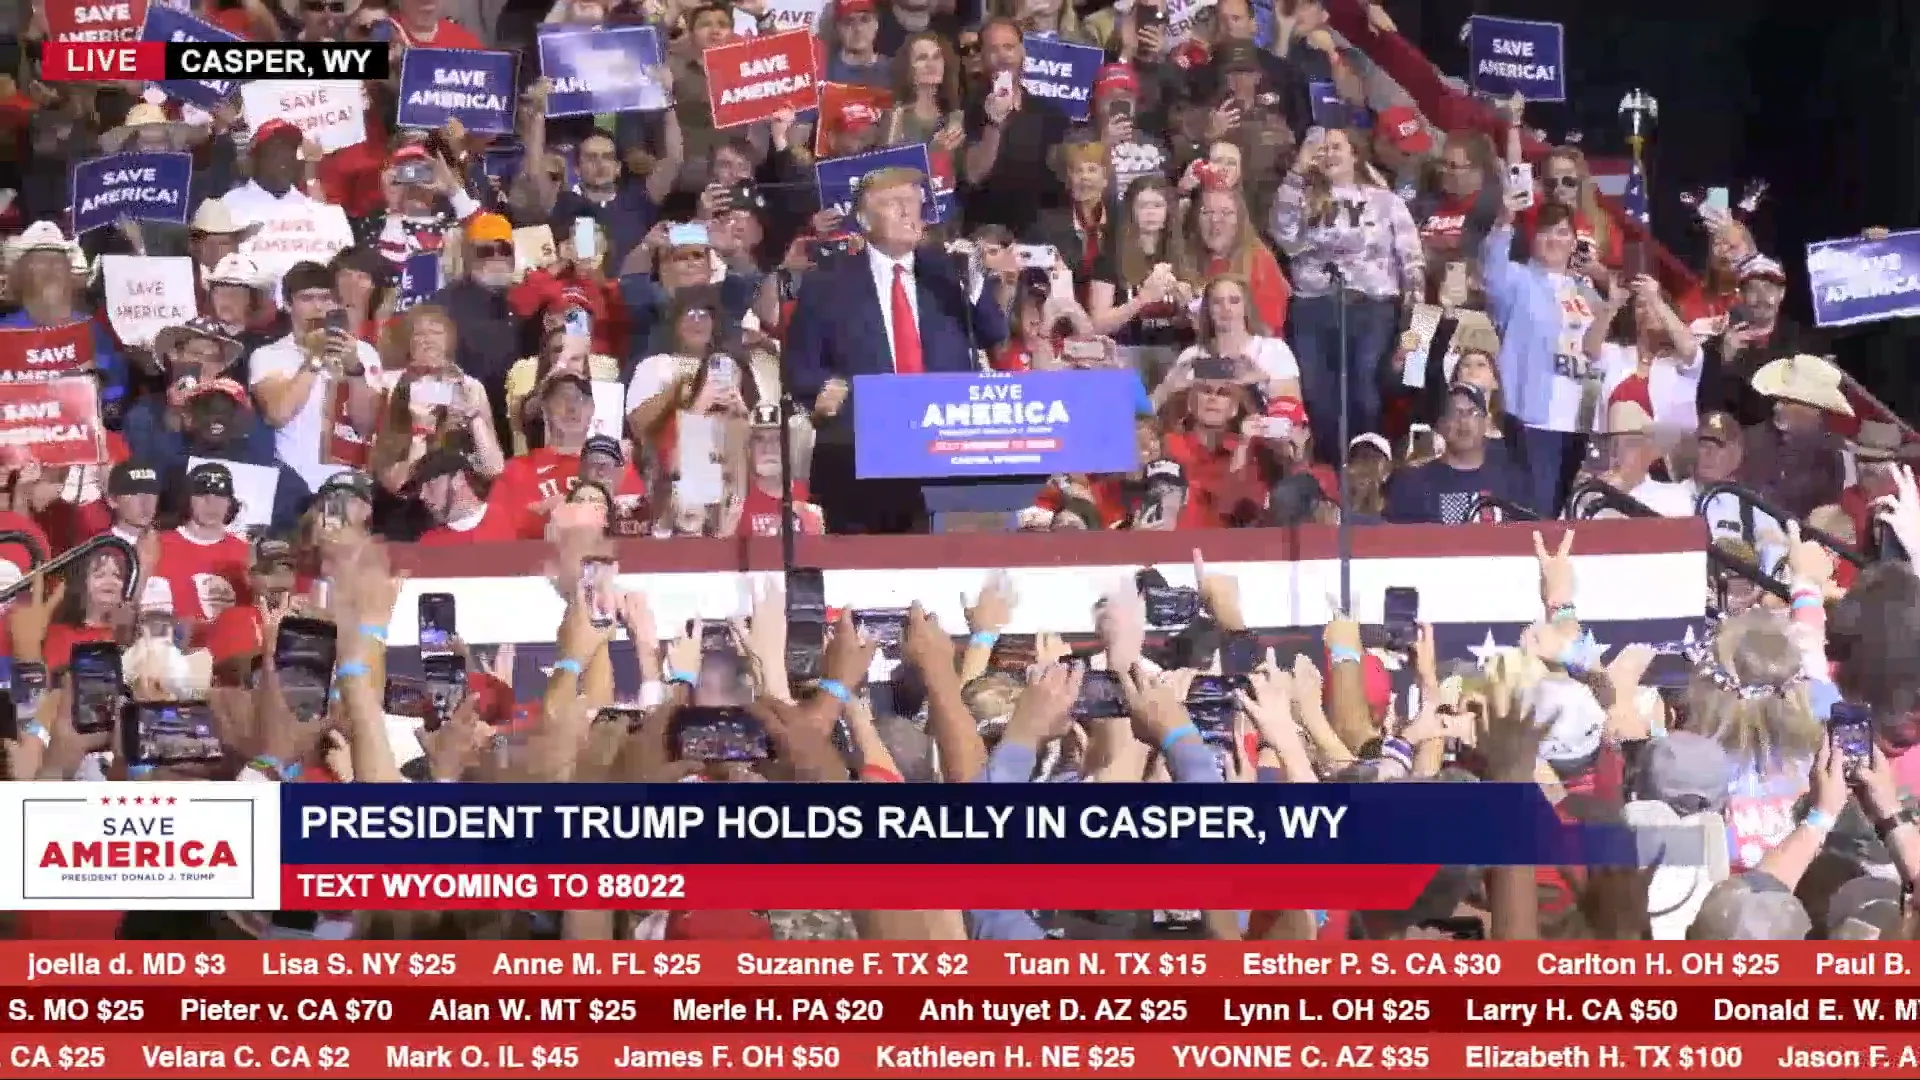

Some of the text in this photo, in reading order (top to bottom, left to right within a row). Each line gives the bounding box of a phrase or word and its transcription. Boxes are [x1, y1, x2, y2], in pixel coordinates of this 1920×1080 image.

[74, 4, 131, 24] SAVE
[58, 27, 144, 42] AMERIC
[1492, 38, 1534, 57] SAVE
[740, 54, 790, 77] SAVE
[1479, 59, 1555, 81] AMERICA!
[433, 67, 486, 88] SAVE
[720, 73, 811, 105] AMERICA!
[279, 89, 329, 112] SAVE
[102, 168, 157, 186] SAVE
[80, 187, 180, 214] AMERICA!
[26, 343, 77, 363] SAVE
[968, 384, 1023, 401] SAVE
[4, 401, 62, 421] SAVE
[920, 400, 1070, 428] AMERICA
